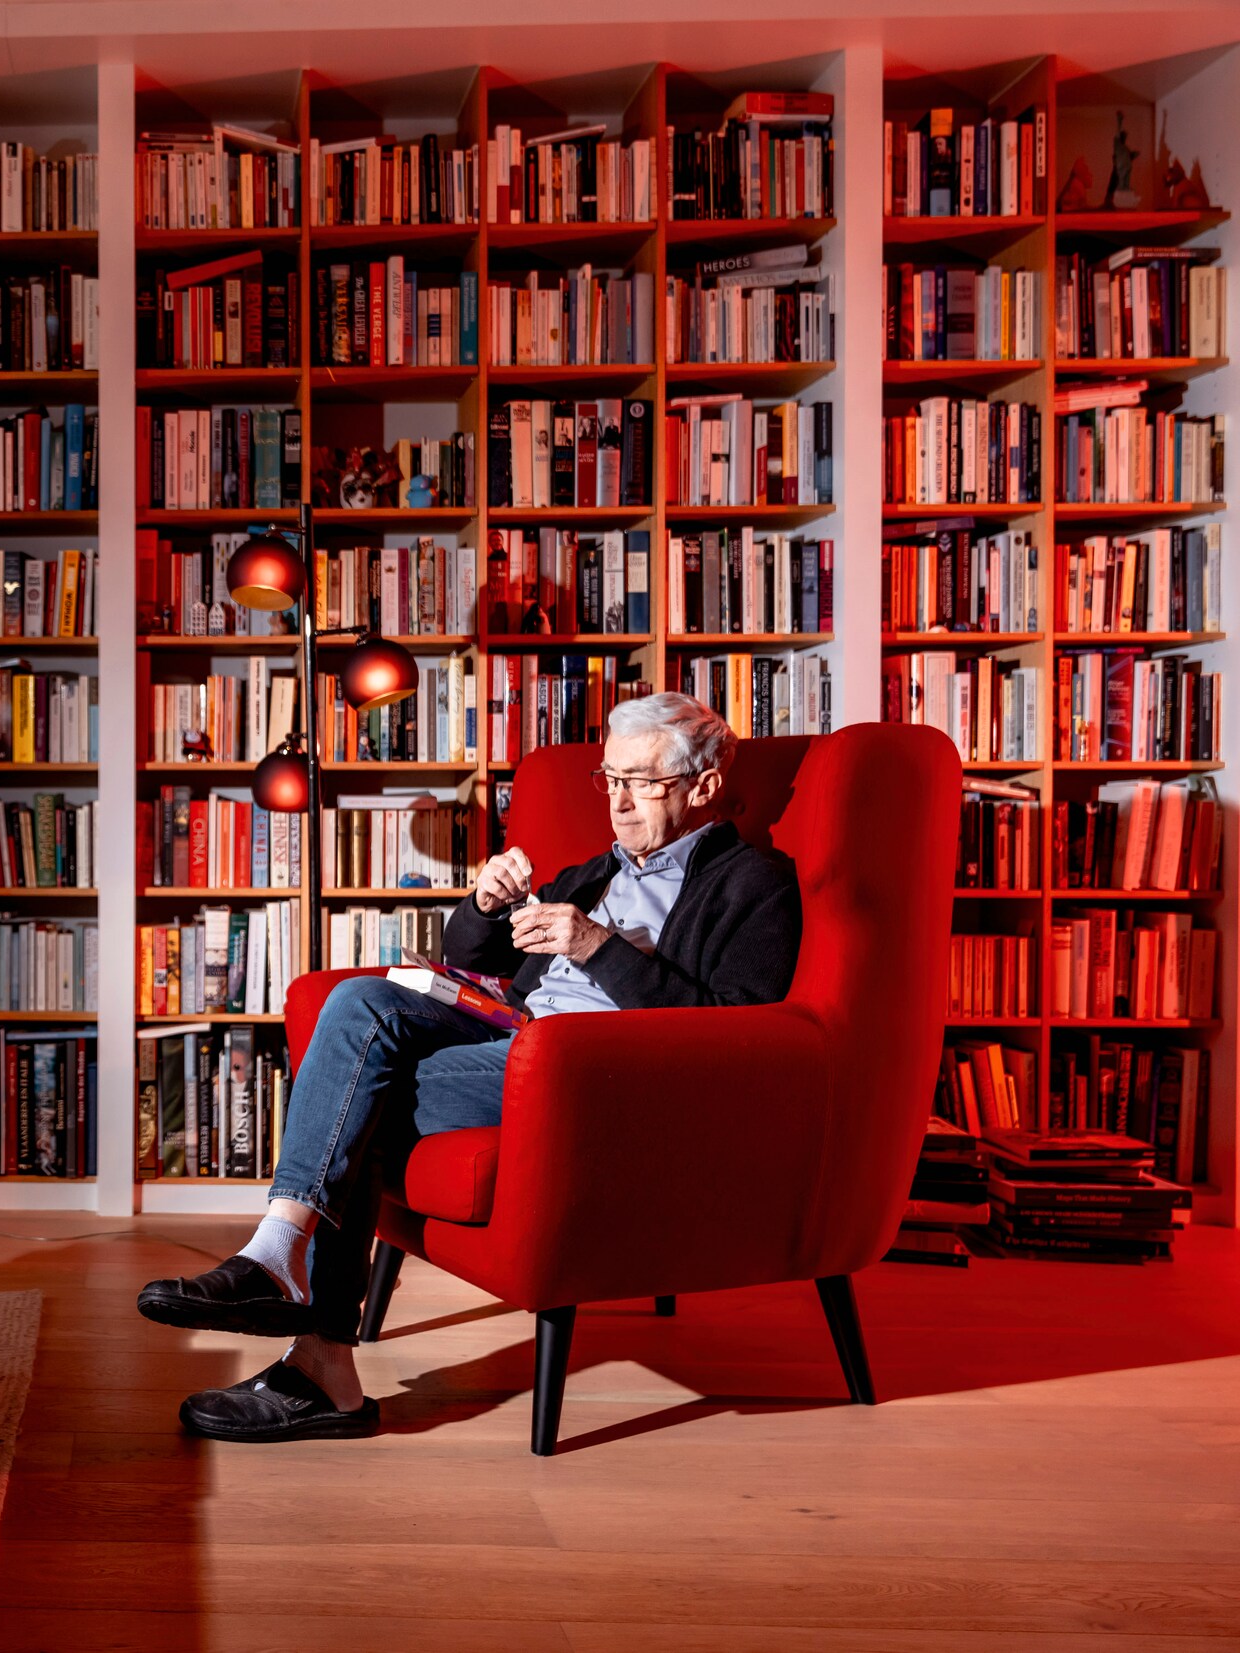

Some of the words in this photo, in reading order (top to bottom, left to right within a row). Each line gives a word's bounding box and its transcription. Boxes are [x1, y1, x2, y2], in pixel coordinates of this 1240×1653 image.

[703, 257, 750, 273] HEROES
[354, 291, 365, 312] GREAT
[372, 286, 382, 304] THE
[392, 272, 401, 319] ANTWERP
[354, 315, 365, 345] LEVELER
[372, 308, 382, 339] VERGE
[463, 568, 473, 609] Sapiens
[762, 662, 770, 697] FRANCIS
[762, 698, 770, 738] FUKUYAM
[39, 796, 55, 870] SHAKESPEARE
[193, 817, 206, 866] CHINA
[255, 813, 267, 854] CHINA
[461, 993, 482, 1007] Lessons
[20, 1059, 29, 1087] ITALIE
[20, 1088, 29, 1100] EN
[20, 1100, 29, 1158] VLAANDEREN
[234, 1090, 250, 1154] BOSCH
[200, 1126, 209, 1164] RETABELS
